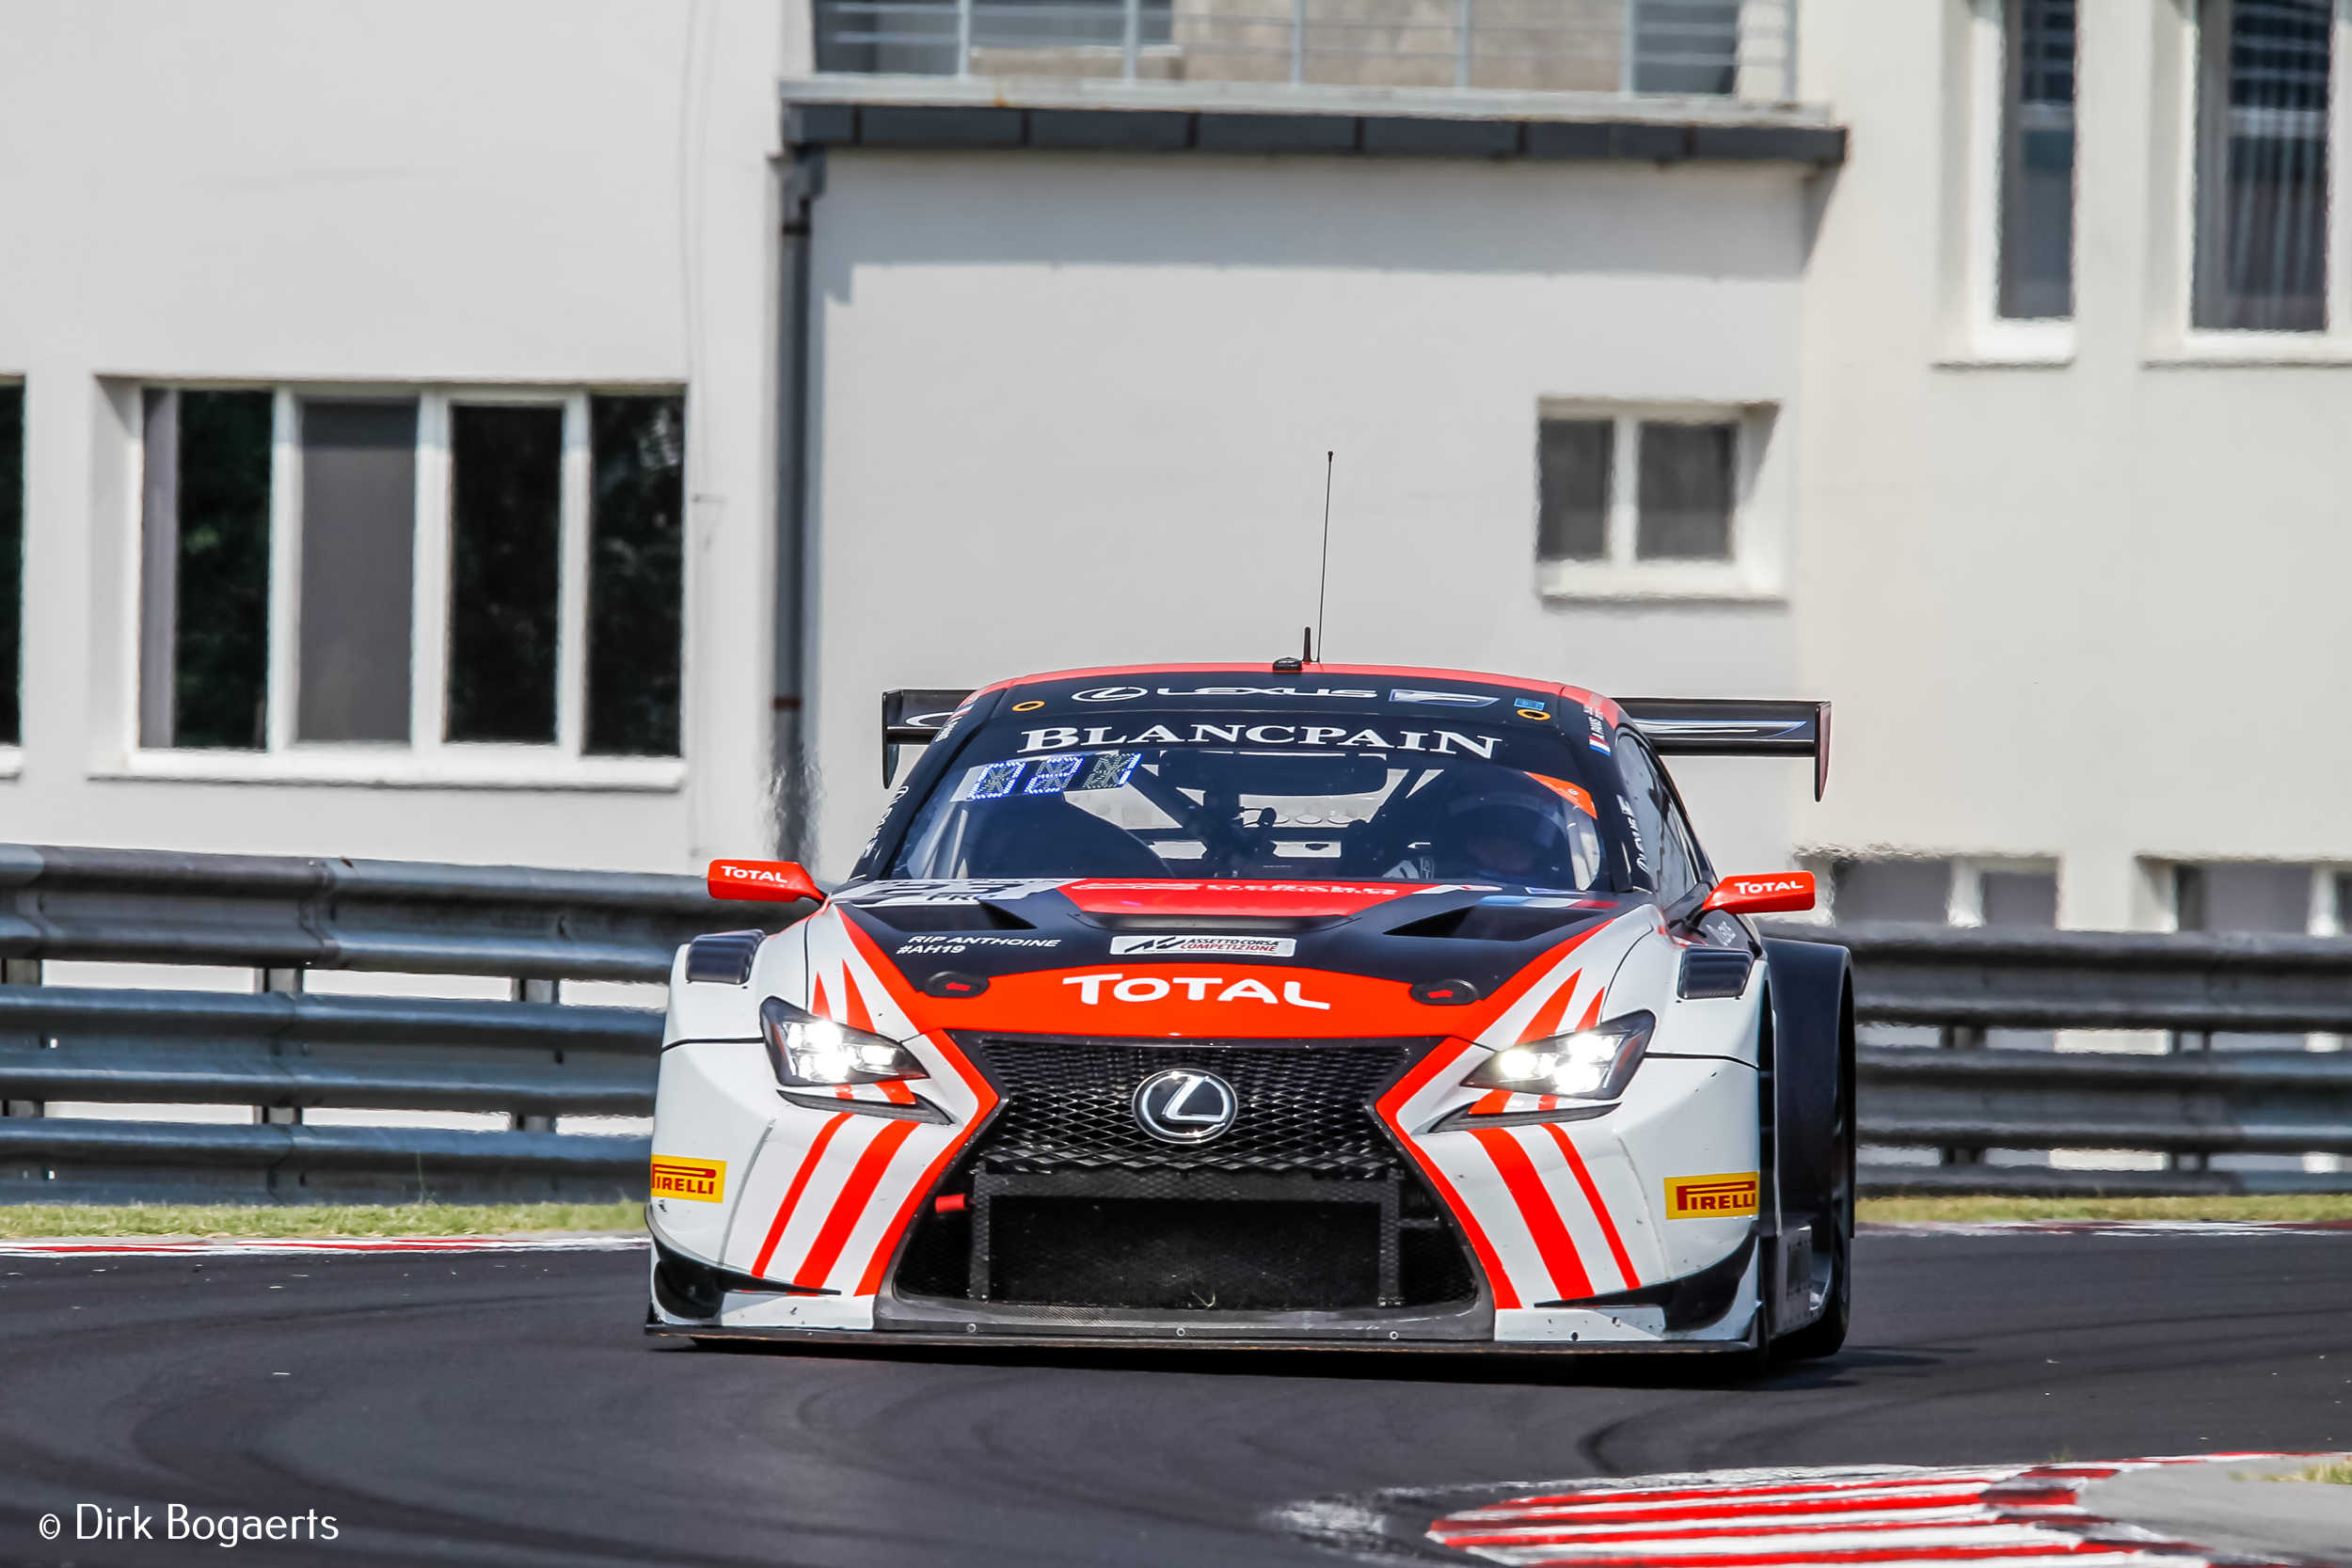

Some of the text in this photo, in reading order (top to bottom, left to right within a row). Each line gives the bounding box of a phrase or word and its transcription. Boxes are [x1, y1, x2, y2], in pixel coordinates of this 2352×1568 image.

[1156, 687, 1378, 698] LEXUS
[1016, 723, 1502, 759] BLANCPAIN
[721, 864, 788, 883] TOTAL
[1734, 880, 1804, 895] TOTAL
[907, 935, 1062, 948] RIP ANTHOINE
[1180, 942, 1278, 952] COMPETIZIONE
[896, 944, 967, 955] #AH19
[1062, 973, 1331, 1011] TOTAL
[1676, 1180, 1756, 1212] PIRELLI
